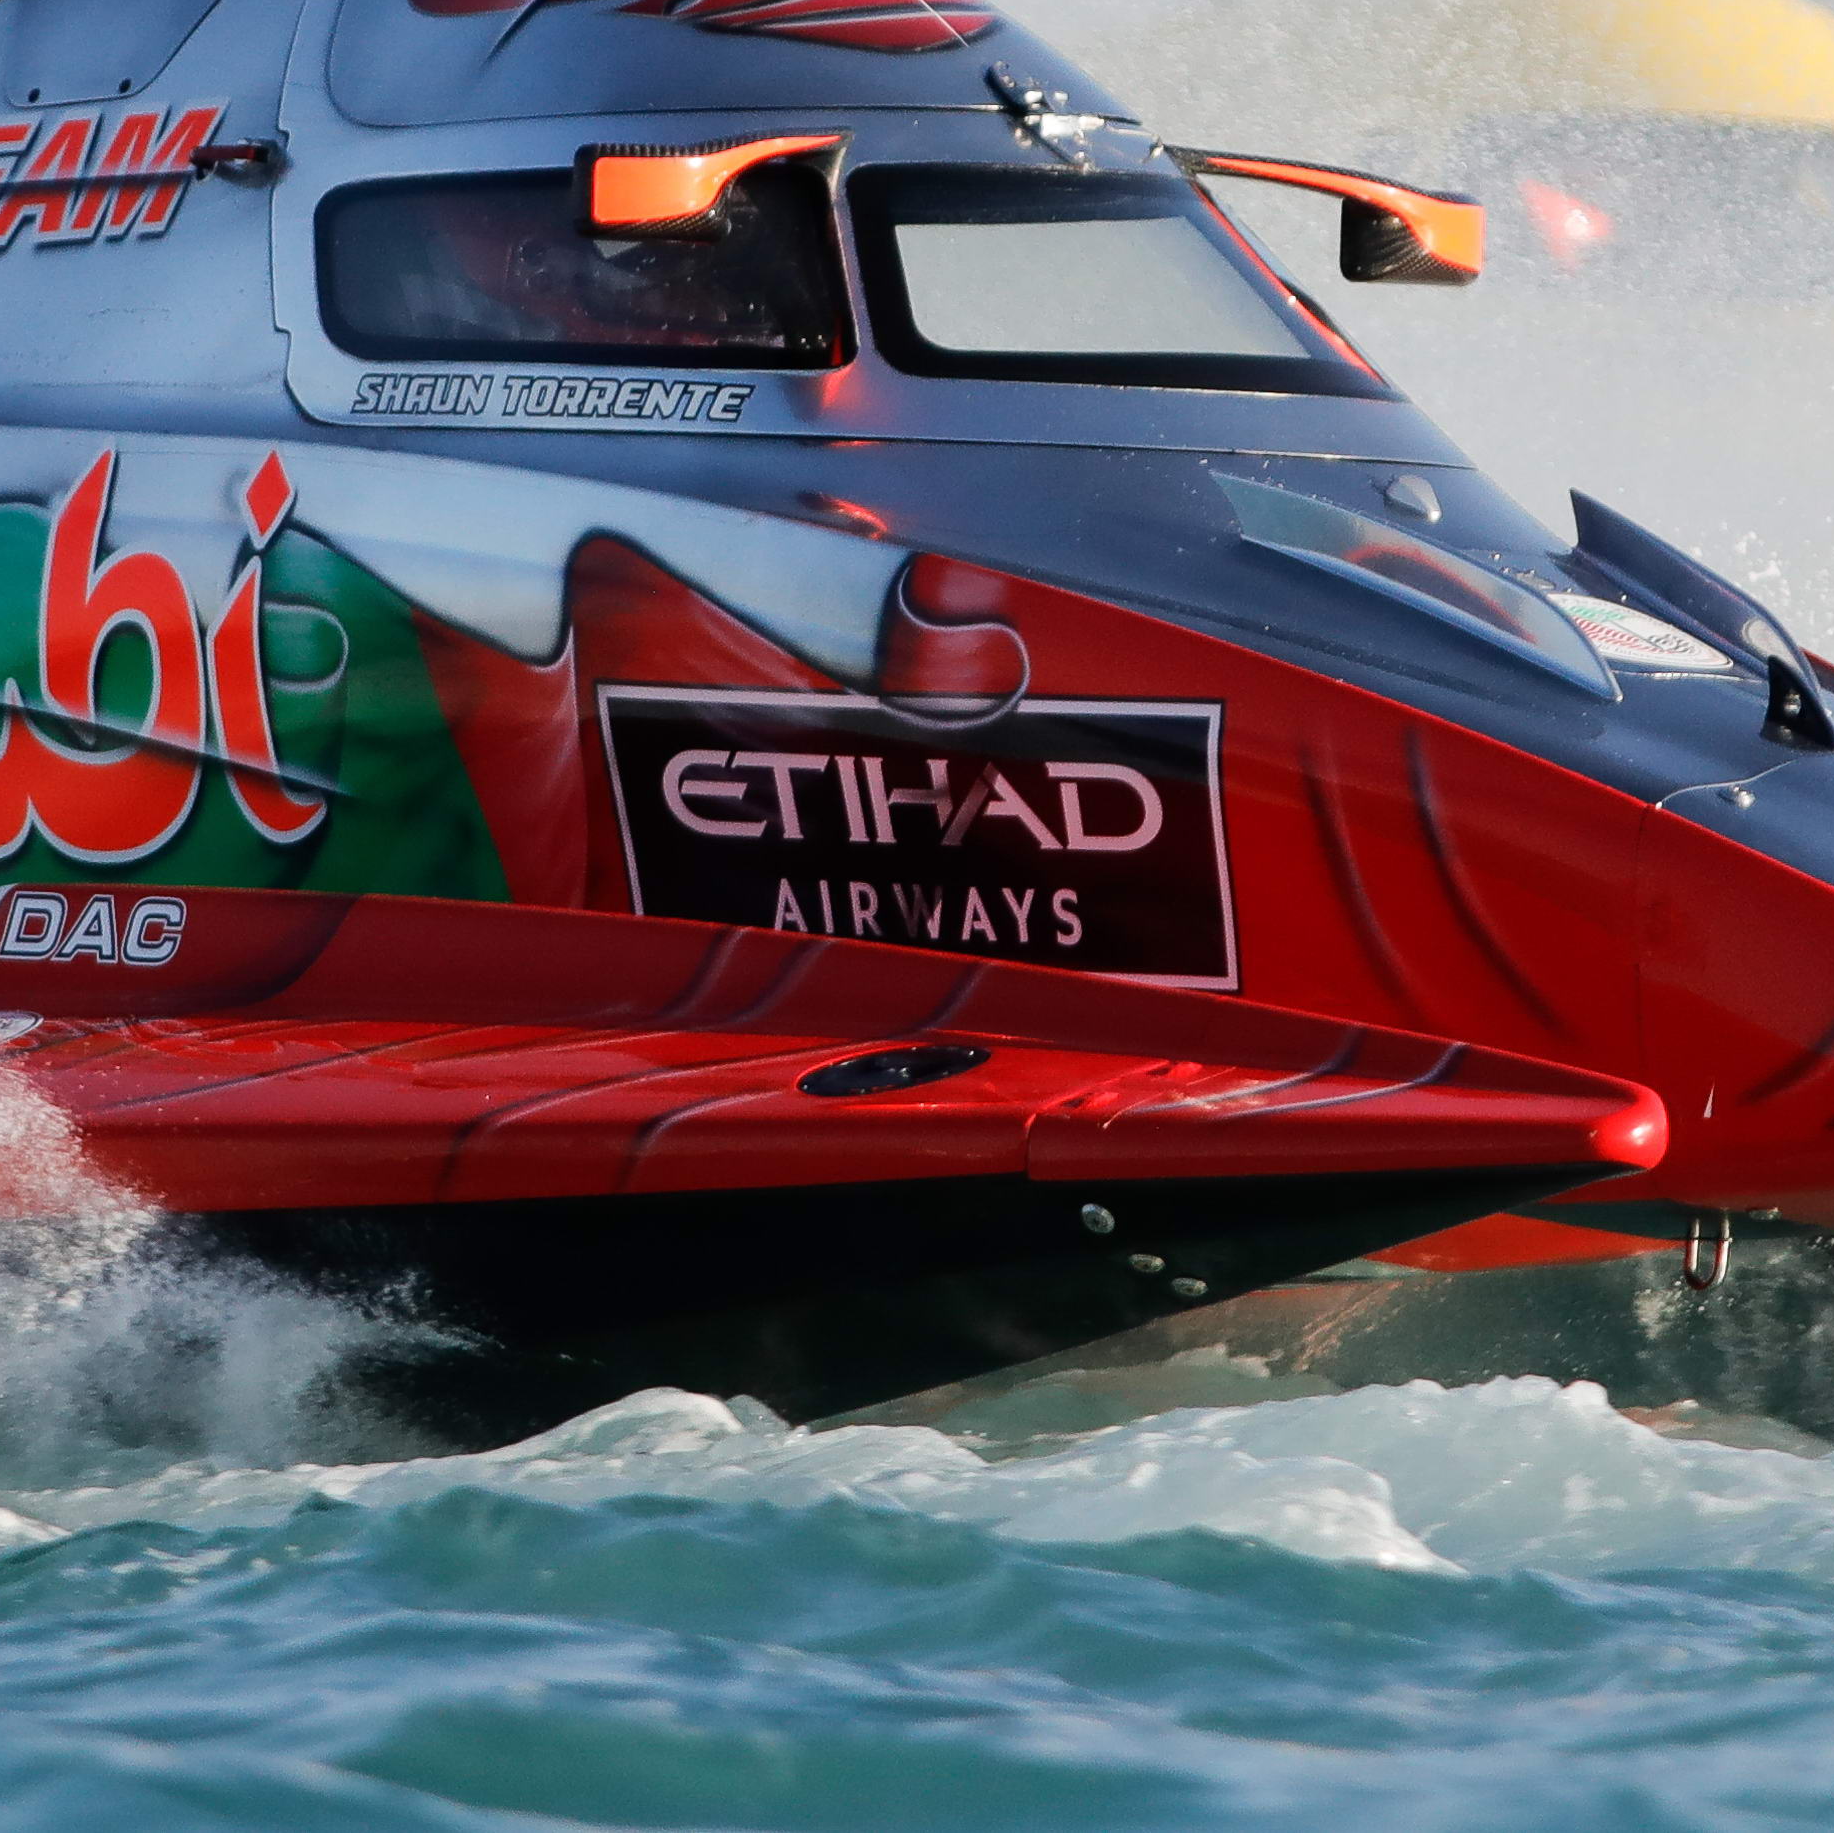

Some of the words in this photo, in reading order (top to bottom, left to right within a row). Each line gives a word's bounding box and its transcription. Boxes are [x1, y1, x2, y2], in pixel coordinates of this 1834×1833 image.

[351, 372, 493, 416] SHAUN
[501, 376, 756, 422] TORRENTE
[661, 748, 1164, 852] ETIHAD
[773, 877, 1084, 946] AIRWAYS
